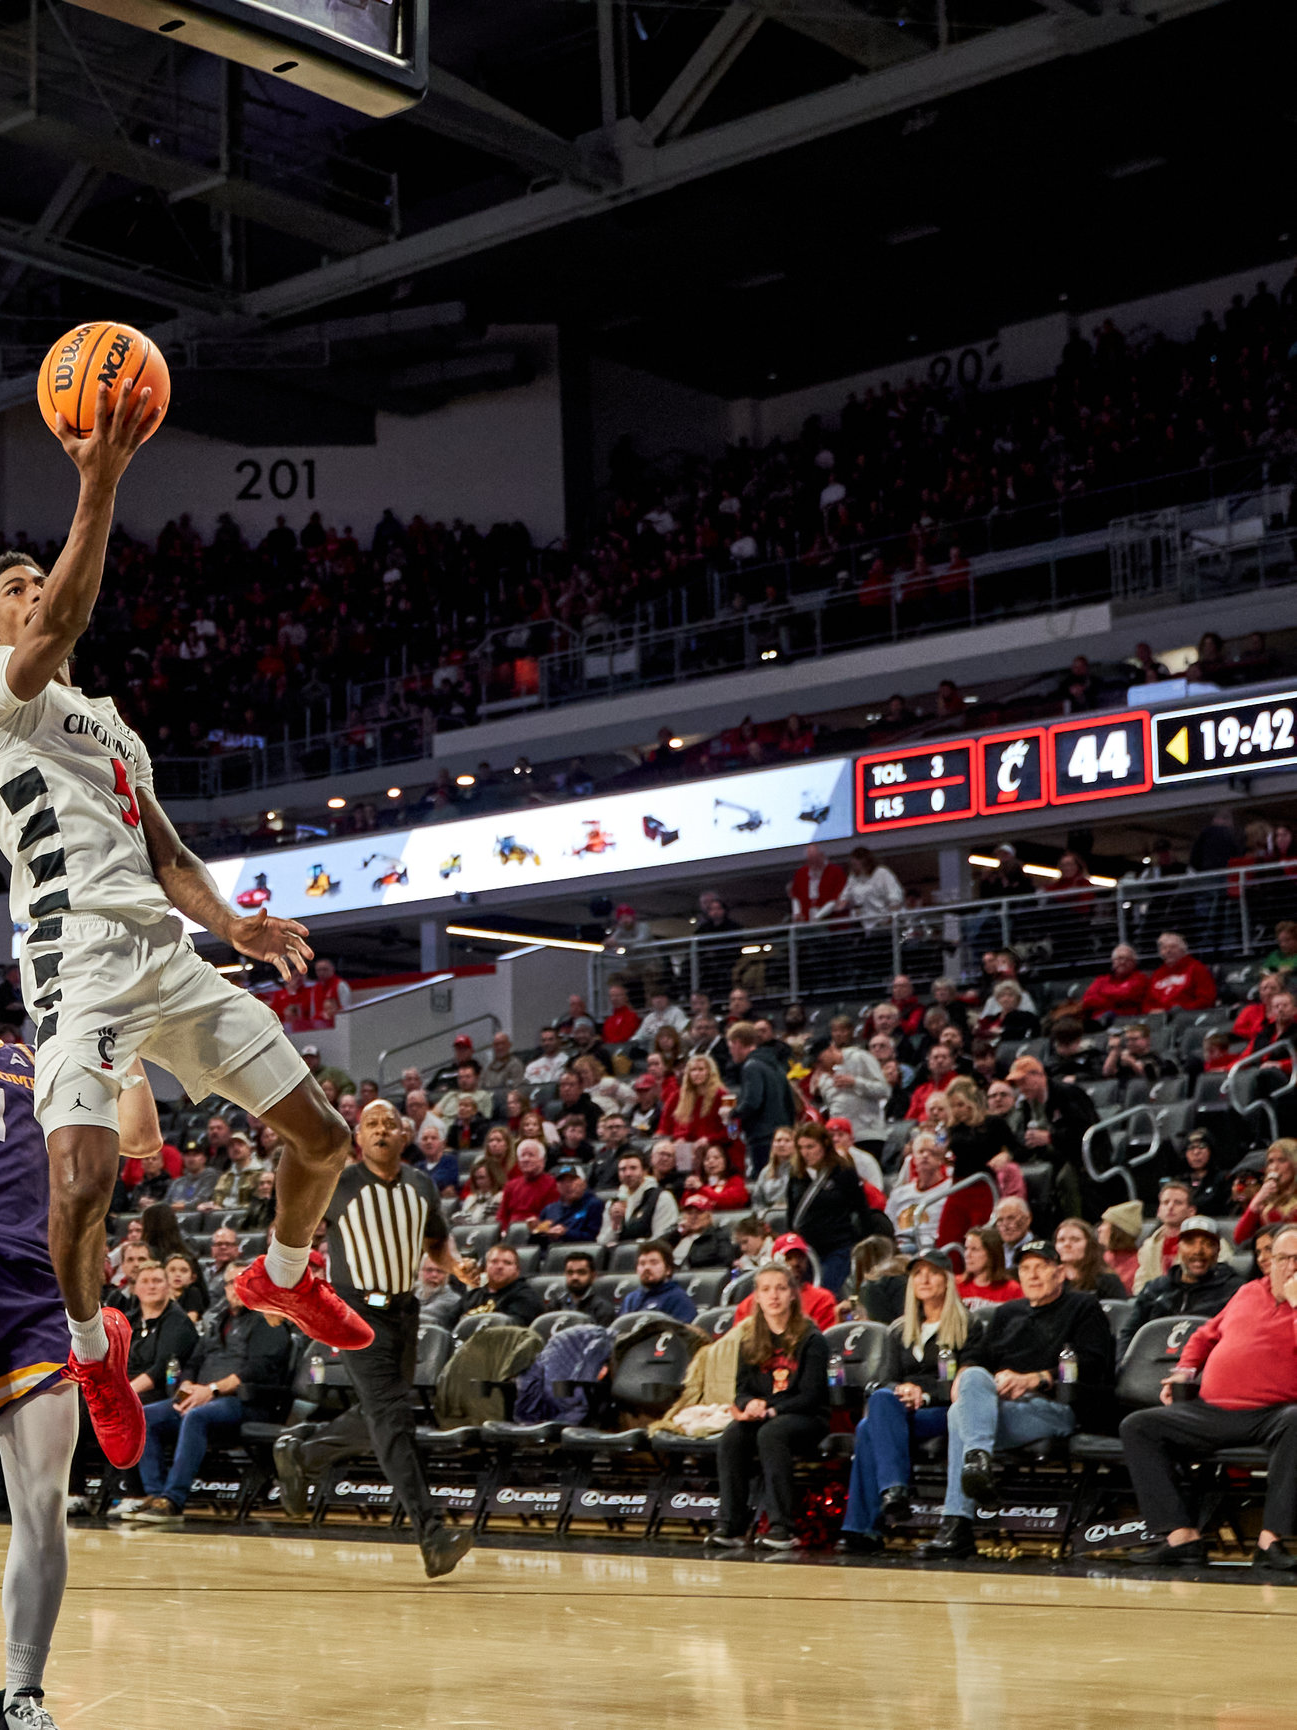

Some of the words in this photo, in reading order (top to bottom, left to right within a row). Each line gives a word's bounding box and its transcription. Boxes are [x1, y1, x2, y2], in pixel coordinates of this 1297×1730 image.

[97, 334, 133, 388] NCAA
[236, 459, 315, 500] 201
[1200, 708, 1295, 761] 19:42
[1068, 729, 1131, 784] 44
[871, 763, 908, 786] TOL
[930, 755, 945, 778] 3
[874, 796, 905, 819] FLS
[930, 788, 945, 812] 0
[202, 1481, 240, 1491] LEXUS
[351, 1484, 394, 1495] LEXUS
[430, 1486, 476, 1498] LEXUS
[513, 1492, 561, 1502] LEXUS
[599, 1494, 647, 1505] LEXUS
[689, 1497, 721, 1508] LEX
[999, 1507, 1060, 1518] LEXUS
[1108, 1521, 1147, 1536] LEX
